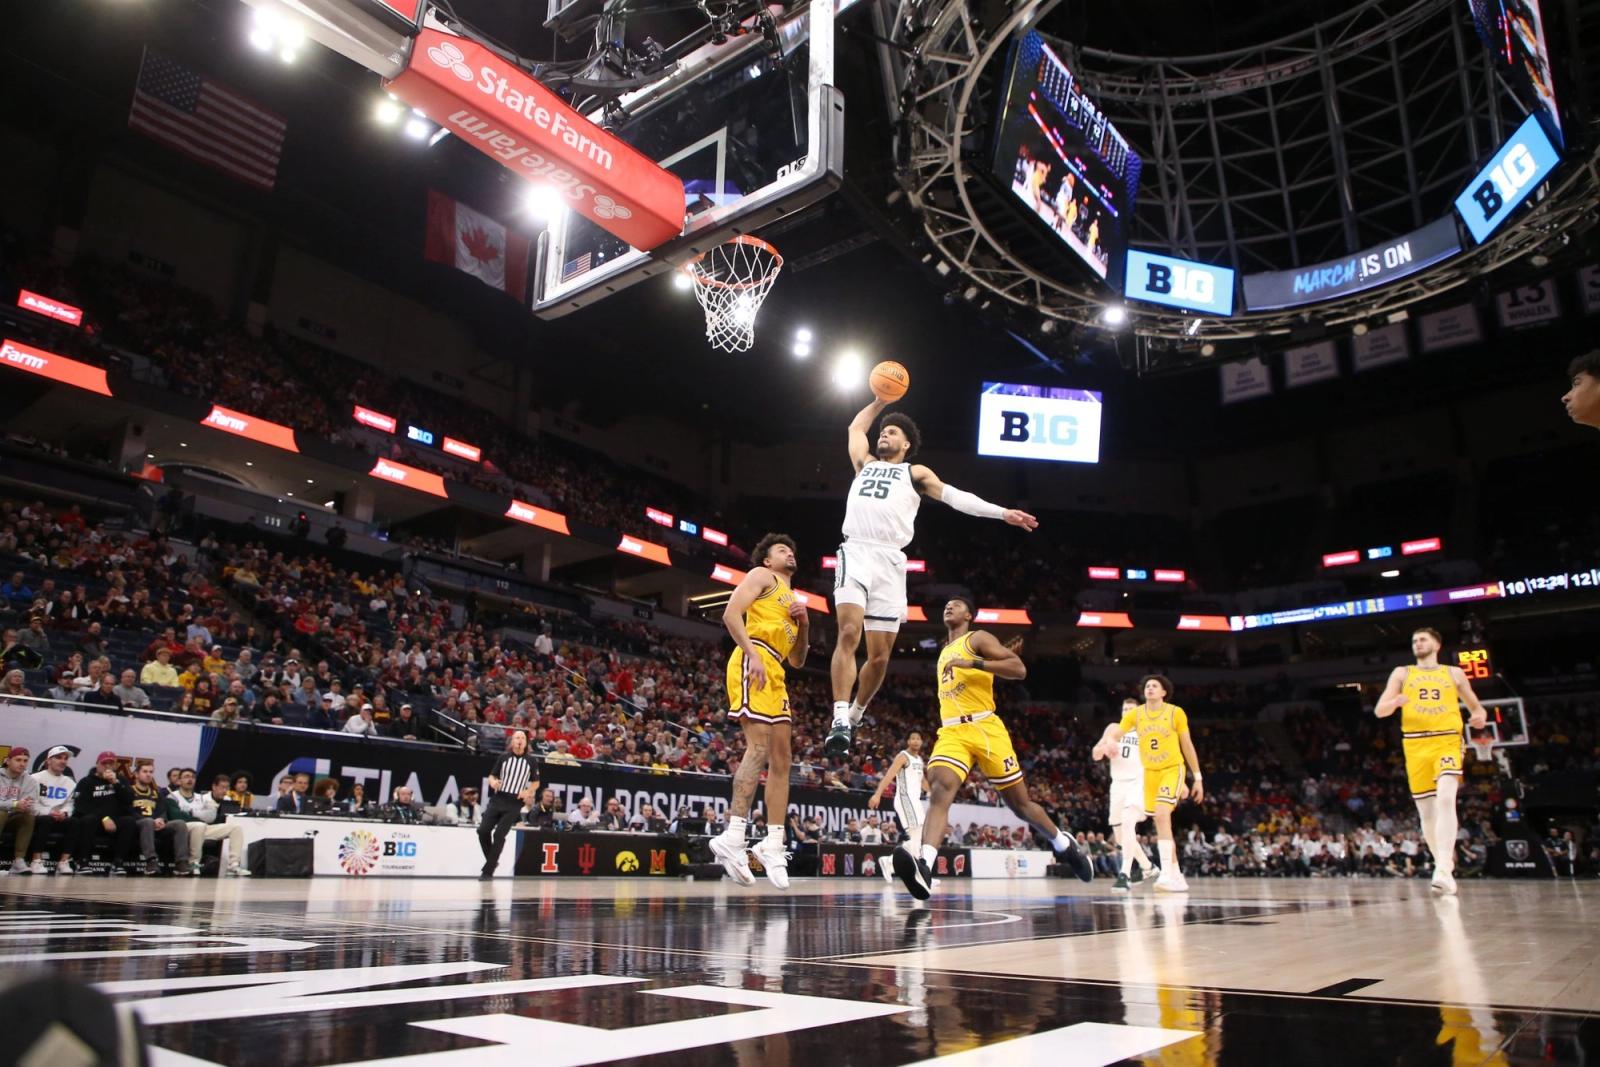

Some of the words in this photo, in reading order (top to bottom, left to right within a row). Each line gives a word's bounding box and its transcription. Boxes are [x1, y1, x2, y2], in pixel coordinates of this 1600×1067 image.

[1293, 259, 1357, 294] MARCH
[1360, 253, 1381, 279] IS
[1383, 240, 1412, 269] ON
[862, 467, 904, 481] STATE
[858, 479, 892, 500] 25
[1505, 581, 1526, 595] 10
[1571, 573, 1592, 587] 12
[1459, 660, 1489, 680] 26
[1419, 688, 1441, 700] 23
[1121, 746, 1131, 758] 0
[1150, 738, 1159, 750] 2
[341, 766, 460, 807] TIAA
[548, 783, 603, 823] TEN
[822, 853, 836, 875] N
[844, 853, 854, 875] N
